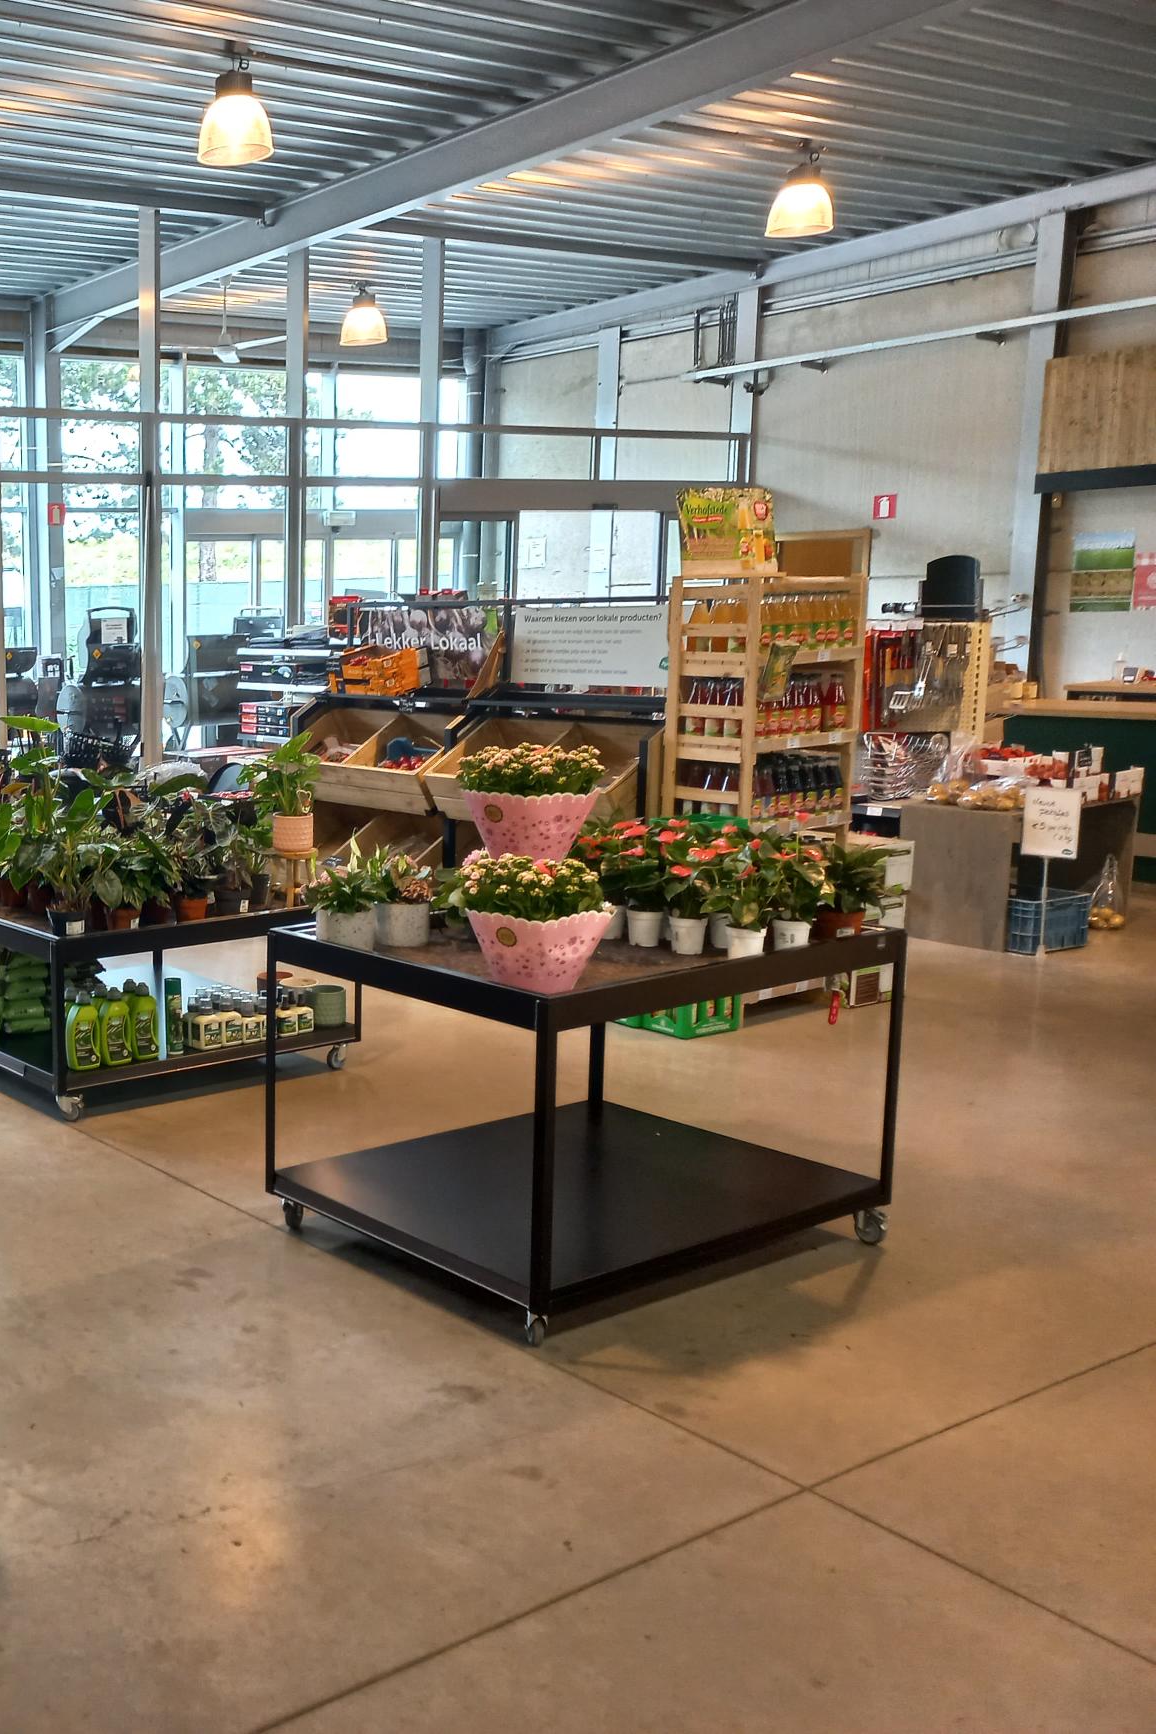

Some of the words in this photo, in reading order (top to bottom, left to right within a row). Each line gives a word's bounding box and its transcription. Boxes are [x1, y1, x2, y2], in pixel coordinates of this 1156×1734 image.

[524, 615, 553, 623] Waarom
[554, 615, 577, 623] kiezen
[596, 614, 618, 622] lokale
[620, 613, 662, 623] producten?
[430, 633, 482, 651] Lokaal
